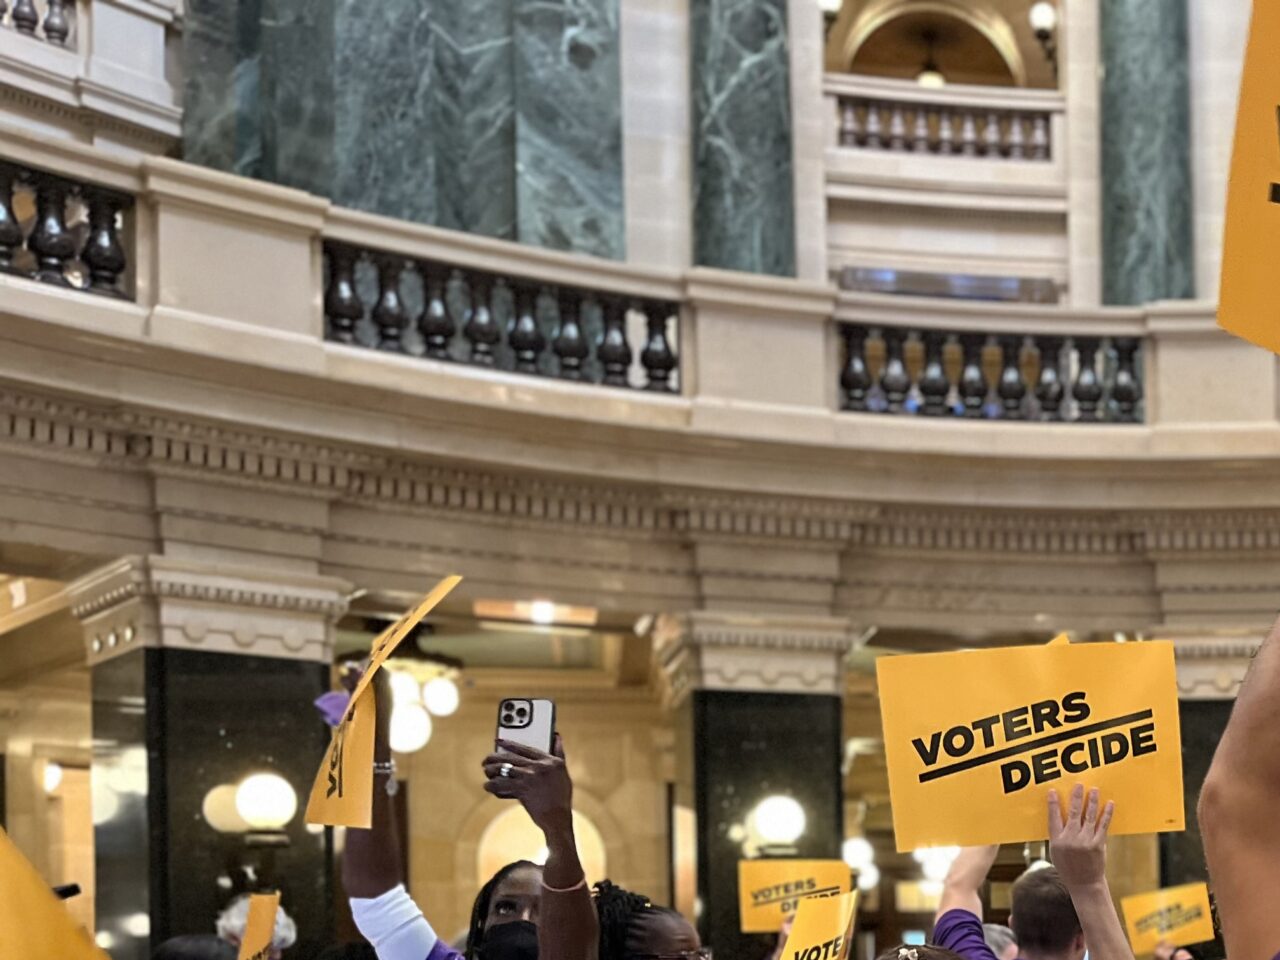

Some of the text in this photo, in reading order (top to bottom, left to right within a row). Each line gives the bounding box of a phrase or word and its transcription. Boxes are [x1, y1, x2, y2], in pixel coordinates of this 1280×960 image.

[911, 691, 1091, 767] VOTERS
[1000, 723, 1157, 795] DECIDE
[752, 877, 816, 901] VOTERS
